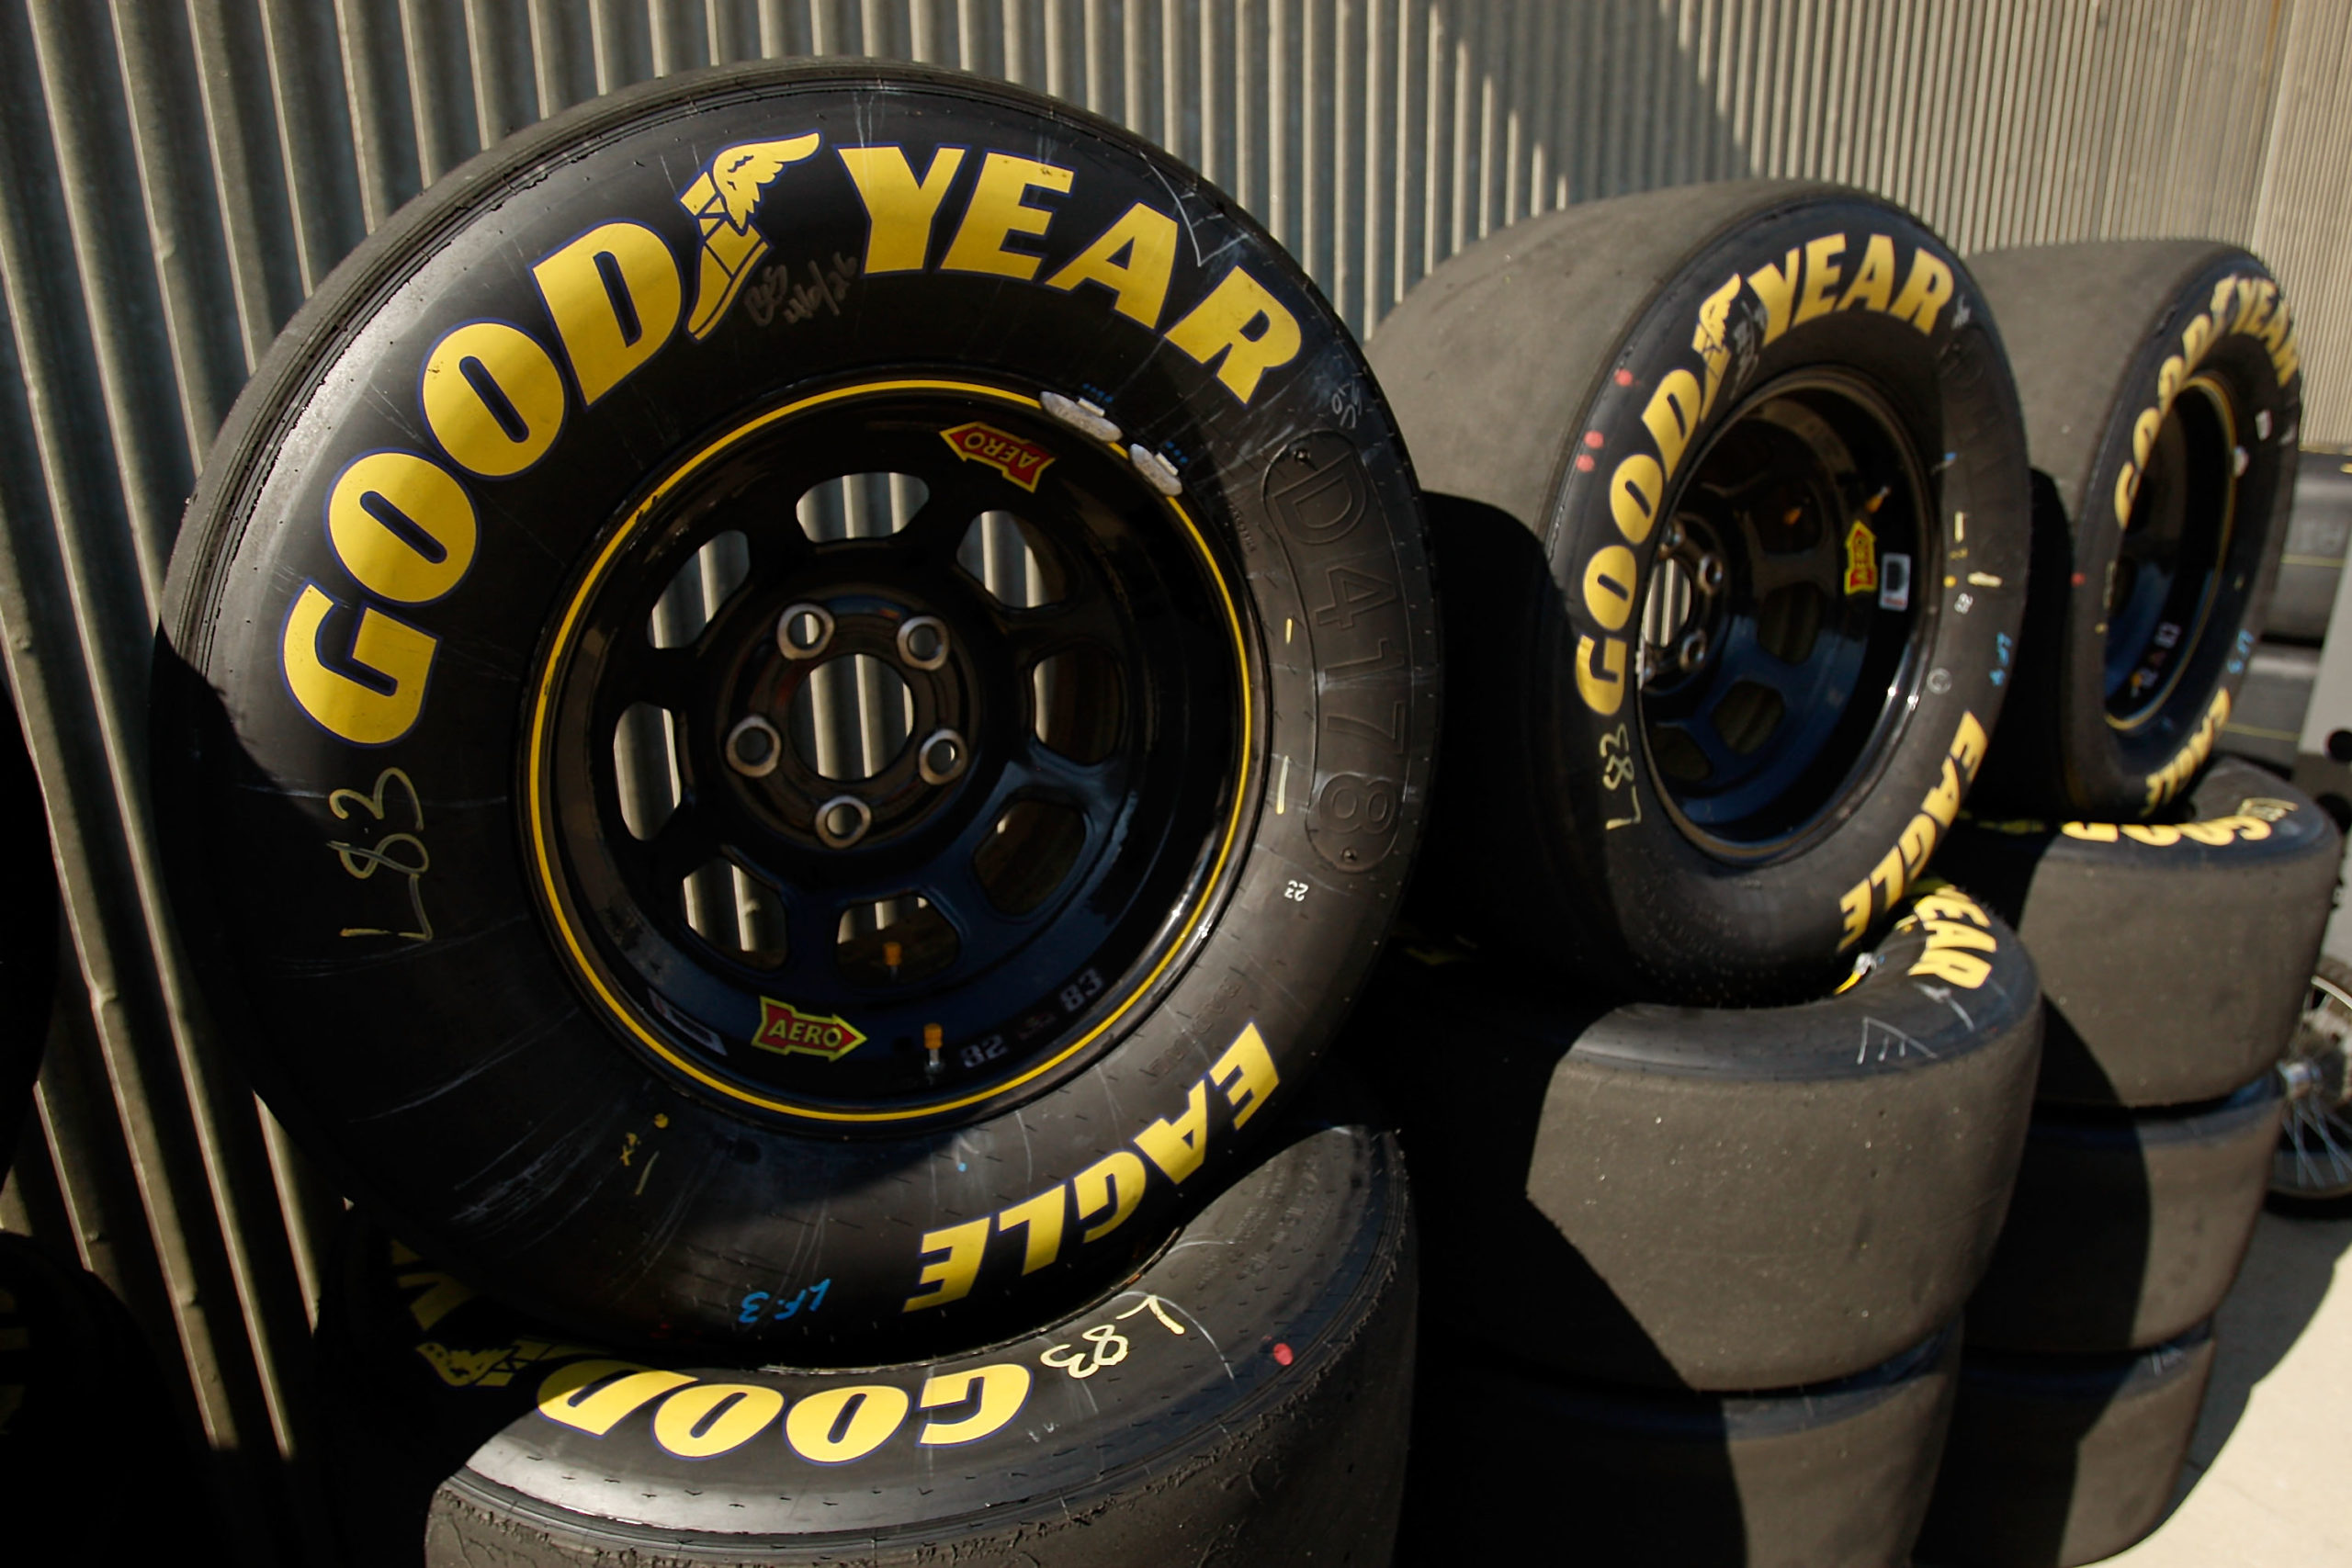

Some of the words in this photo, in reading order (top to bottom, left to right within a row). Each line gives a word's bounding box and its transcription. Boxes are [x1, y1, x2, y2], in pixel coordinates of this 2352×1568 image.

[281, 220, 684, 746] GOOD
[838, 145, 1302, 404] YEAR
[964, 431, 1040, 468] AERO
[1600, 722, 1642, 830] L83
[326, 766, 435, 942] L83
[1838, 710, 1987, 953] EAGLE
[767, 1019, 843, 1048] AERO
[1059, 967, 1104, 1011] 83
[904, 1021, 1281, 1313] EAGLE
[1039, 1294, 1185, 1379] L83
[537, 1359, 1032, 1462] GOOD
